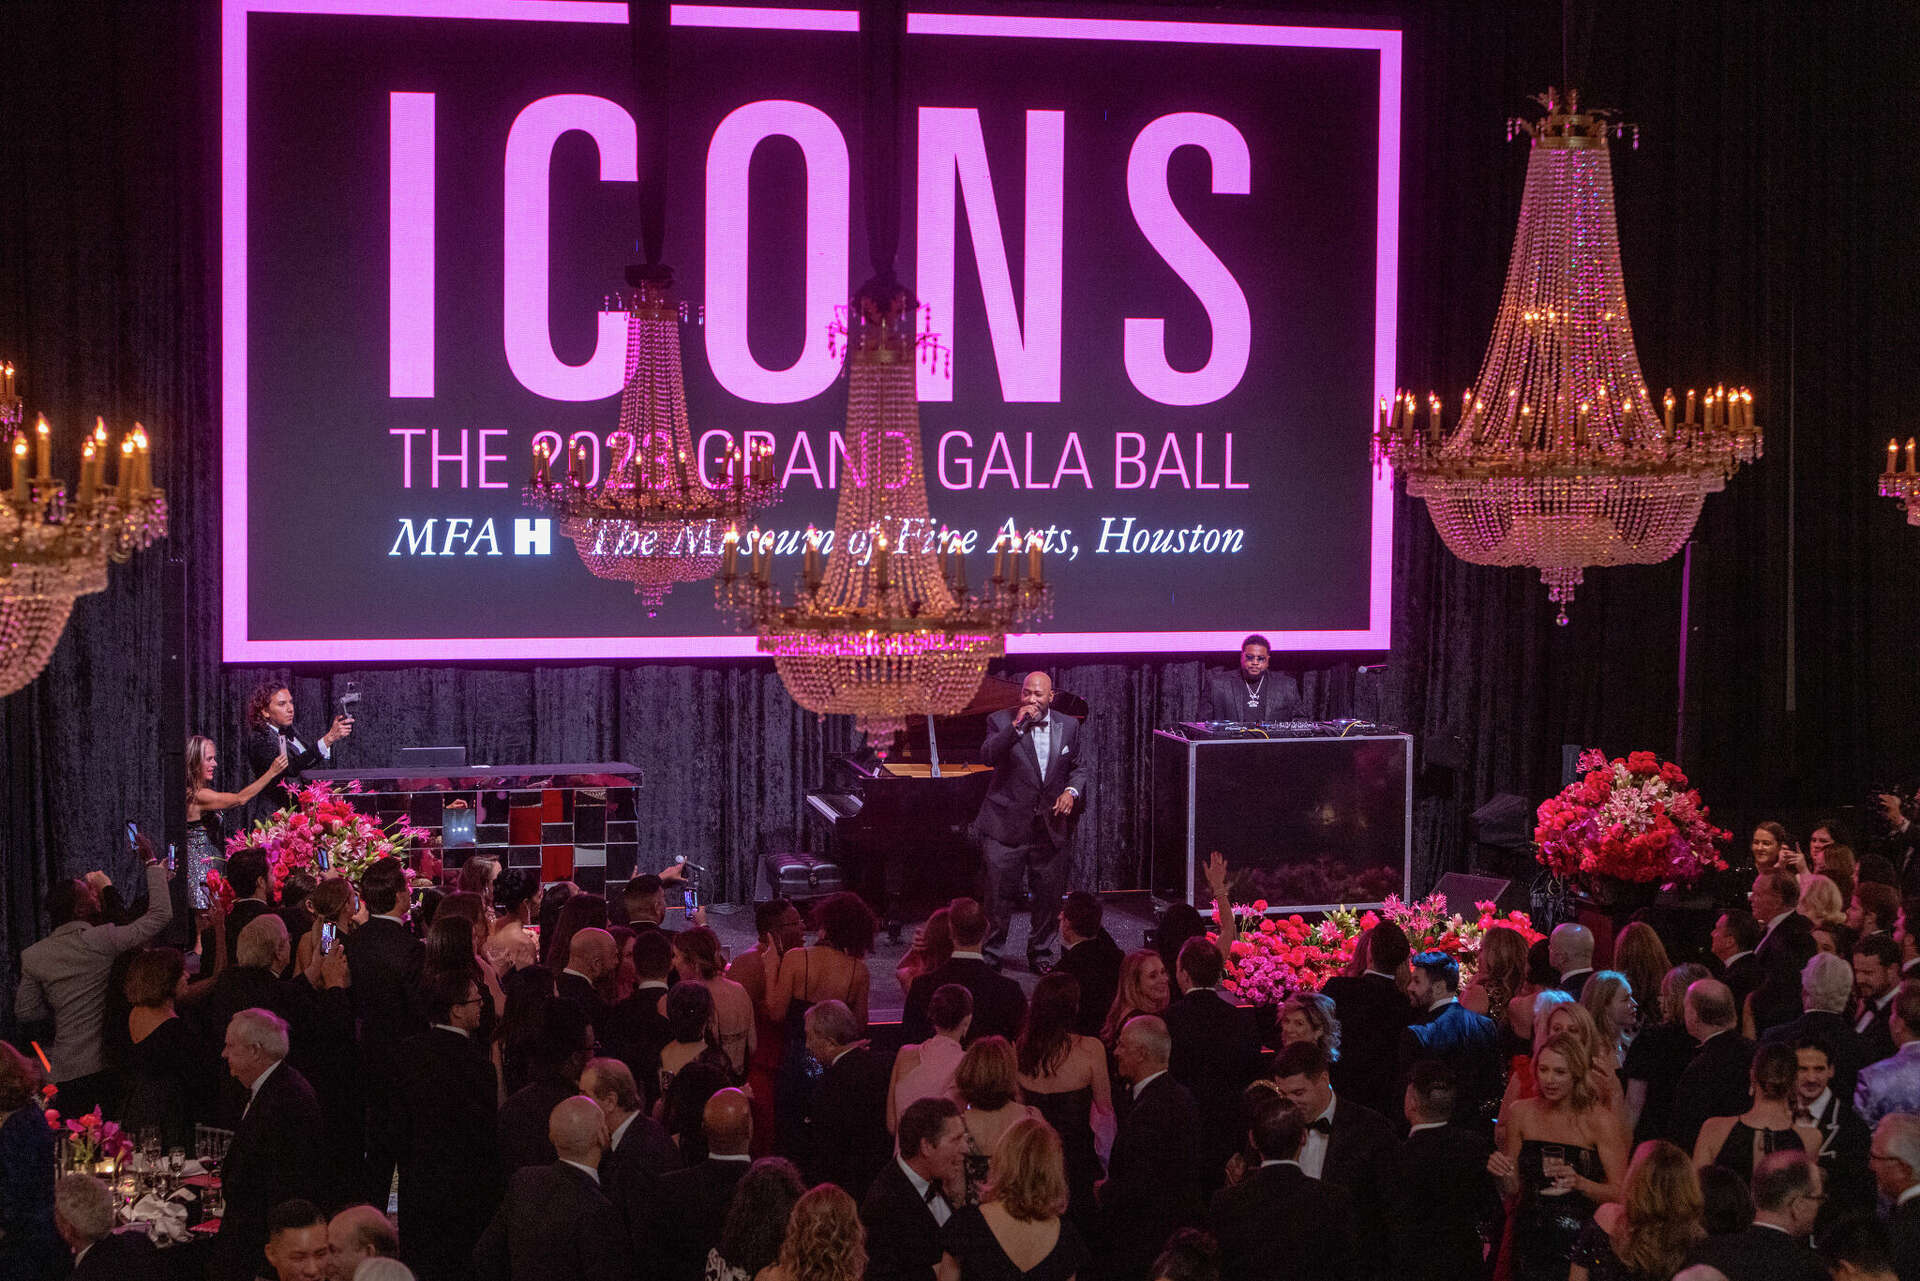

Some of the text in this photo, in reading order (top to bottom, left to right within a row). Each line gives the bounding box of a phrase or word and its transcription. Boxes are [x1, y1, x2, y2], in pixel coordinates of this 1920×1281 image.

[389, 91, 1252, 406] ICONS
[389, 428, 508, 489] THE
[698, 429, 913, 490] GRAND
[937, 430, 1093, 490] GALA
[1115, 432, 1250, 490] BALL
[388, 518, 502, 556] MFA
[586, 517, 658, 556] The
[847, 515, 892, 566] of
[893, 517, 978, 555] Fine
[986, 516, 1080, 561] Arts,
[1096, 516, 1244, 554] Houston
